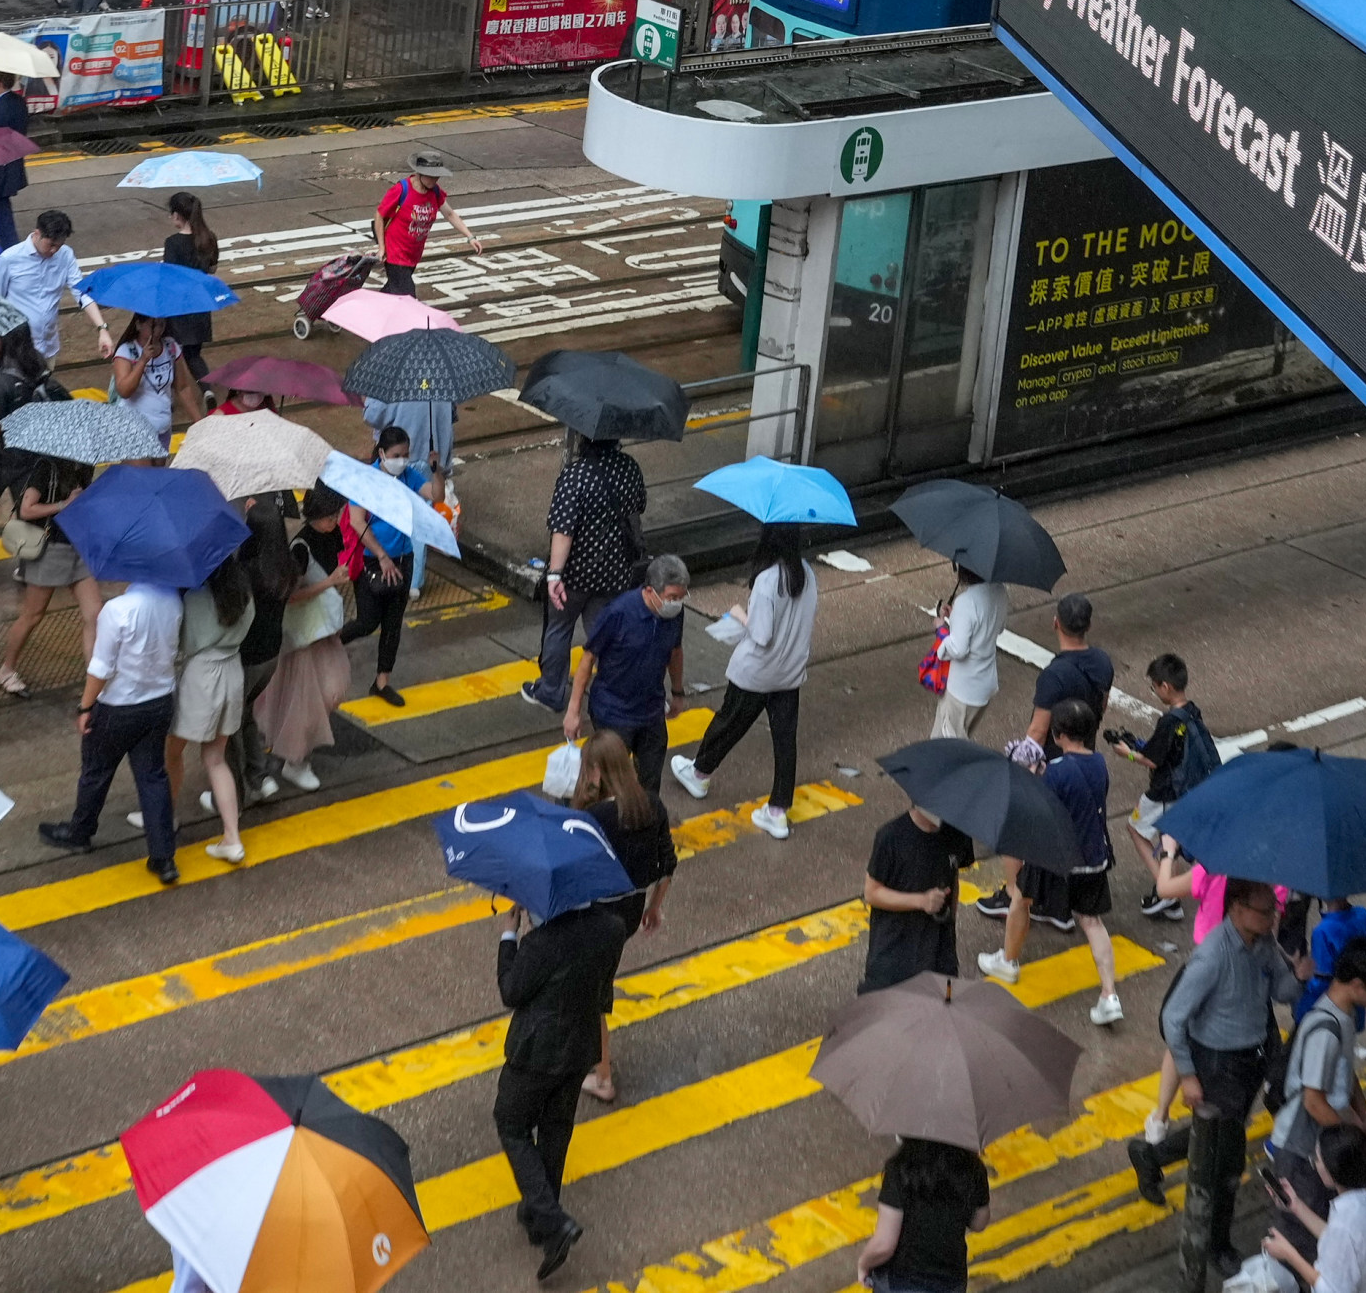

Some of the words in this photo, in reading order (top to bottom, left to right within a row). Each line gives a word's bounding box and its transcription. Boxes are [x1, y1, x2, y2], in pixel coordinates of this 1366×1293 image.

[485, 10, 627, 35] 慶祝香港回歸祖國27周年
[665, 30, 676, 39] 27E
[115, 45, 127, 53] 02
[1171, 27, 1302, 208] Forecast
[1035, 237, 1069, 266] TO
[1082, 227, 1130, 258] THE
[1138, 219, 1197, 249] MOO
[868, 302, 893, 324] 20
[1020, 348, 1069, 369] Discover
[1072, 341, 1103, 359] Value
[1110, 331, 1150, 352] Exceed
[1152, 321, 1210, 344] Limitations
[1017, 374, 1056, 391] Manage
[1062, 367, 1092, 384] crypto
[1098, 361, 1116, 375] and
[1121, 356, 1146, 371] stock
[1015, 395, 1028, 408] on
[1029, 392, 1048, 405] one
[1048, 388, 1068, 404] app
